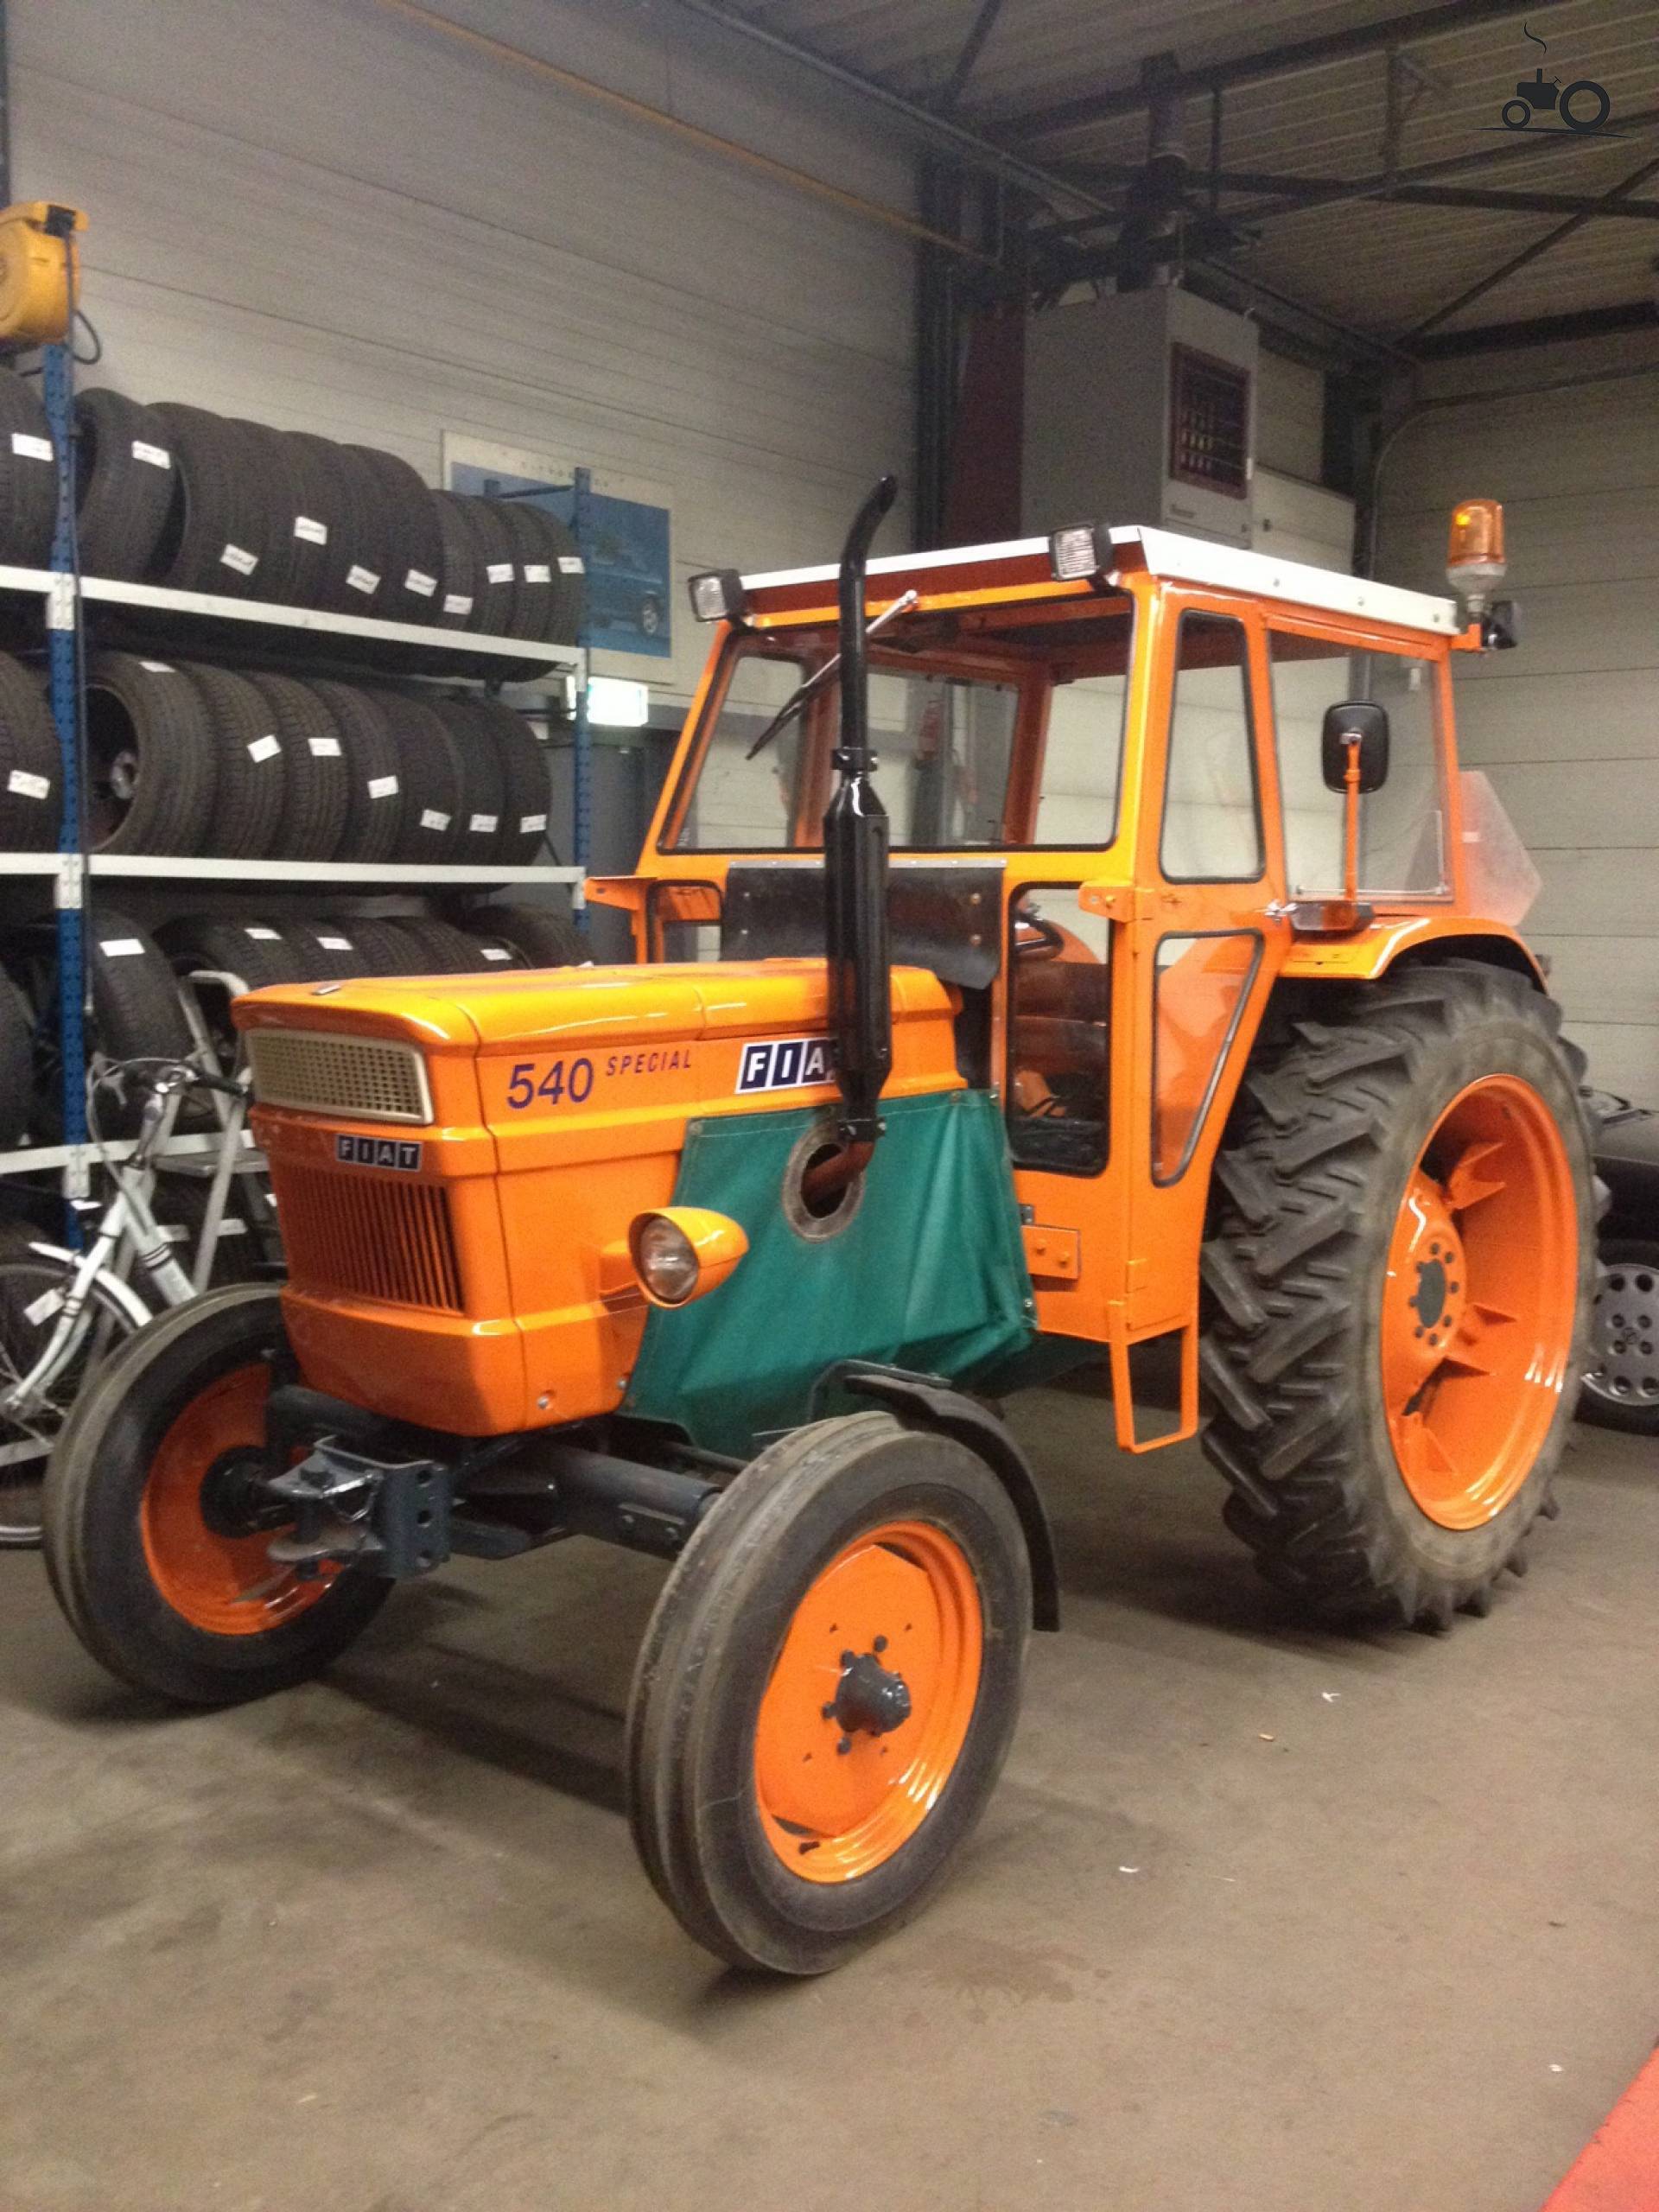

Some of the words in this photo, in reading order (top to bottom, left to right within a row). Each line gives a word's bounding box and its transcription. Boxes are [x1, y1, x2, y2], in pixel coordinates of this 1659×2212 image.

[505, 1058, 594, 1110] 540
[606, 1048, 692, 1077] SPECIAL
[744, 1045, 830, 1084] FIA
[340, 1138, 418, 1166] FIAT
